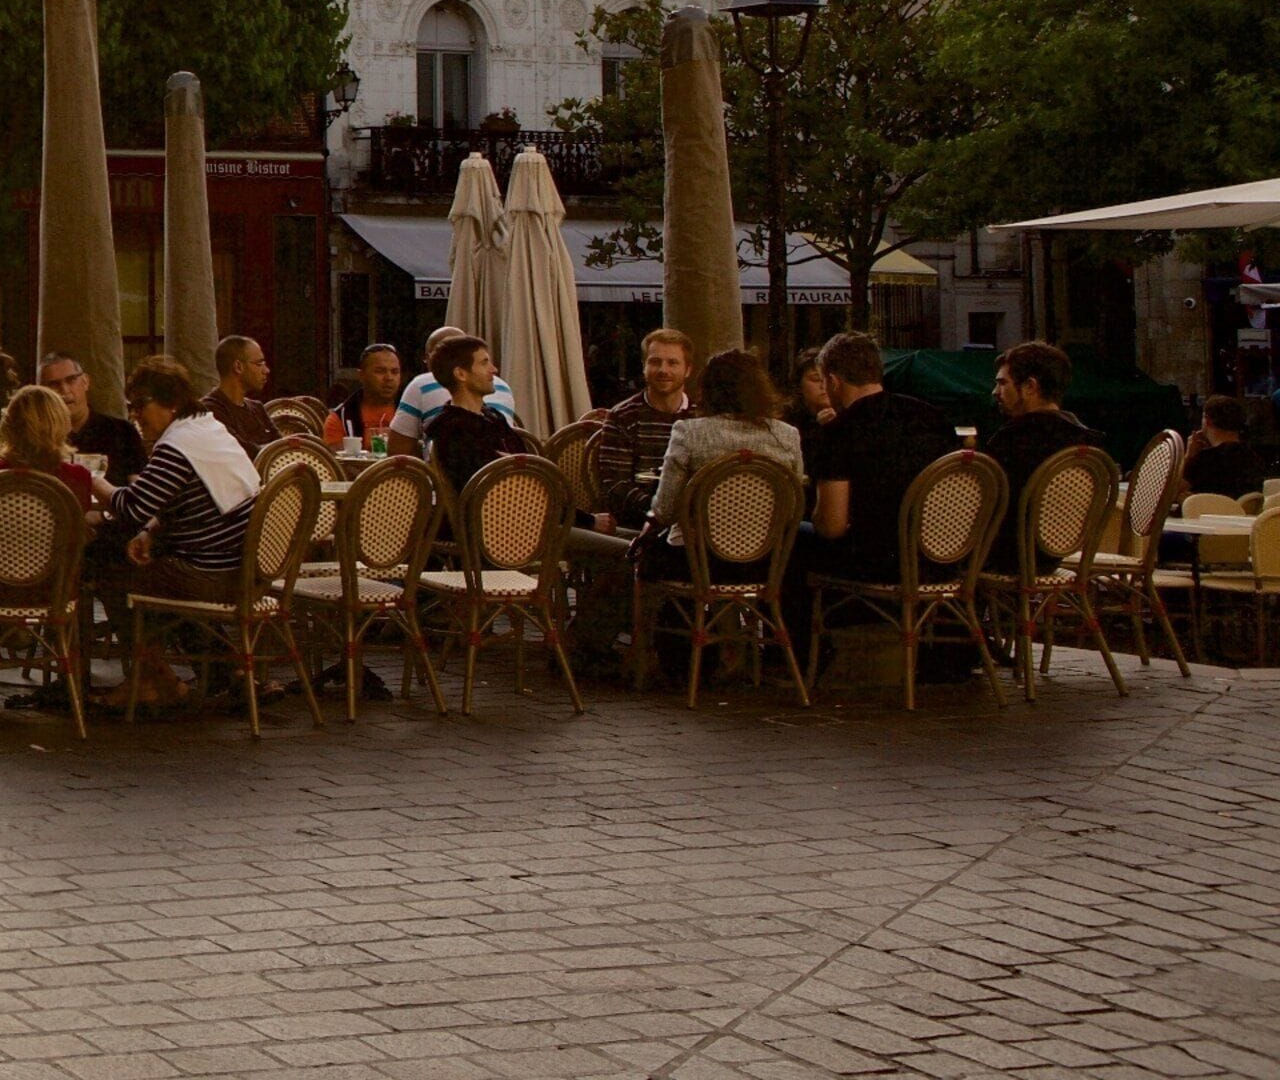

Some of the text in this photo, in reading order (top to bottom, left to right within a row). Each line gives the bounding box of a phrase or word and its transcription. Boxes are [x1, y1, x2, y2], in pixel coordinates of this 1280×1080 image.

[206, 159, 291, 175] uisine Bistrot
[421, 286, 450, 298] BA
